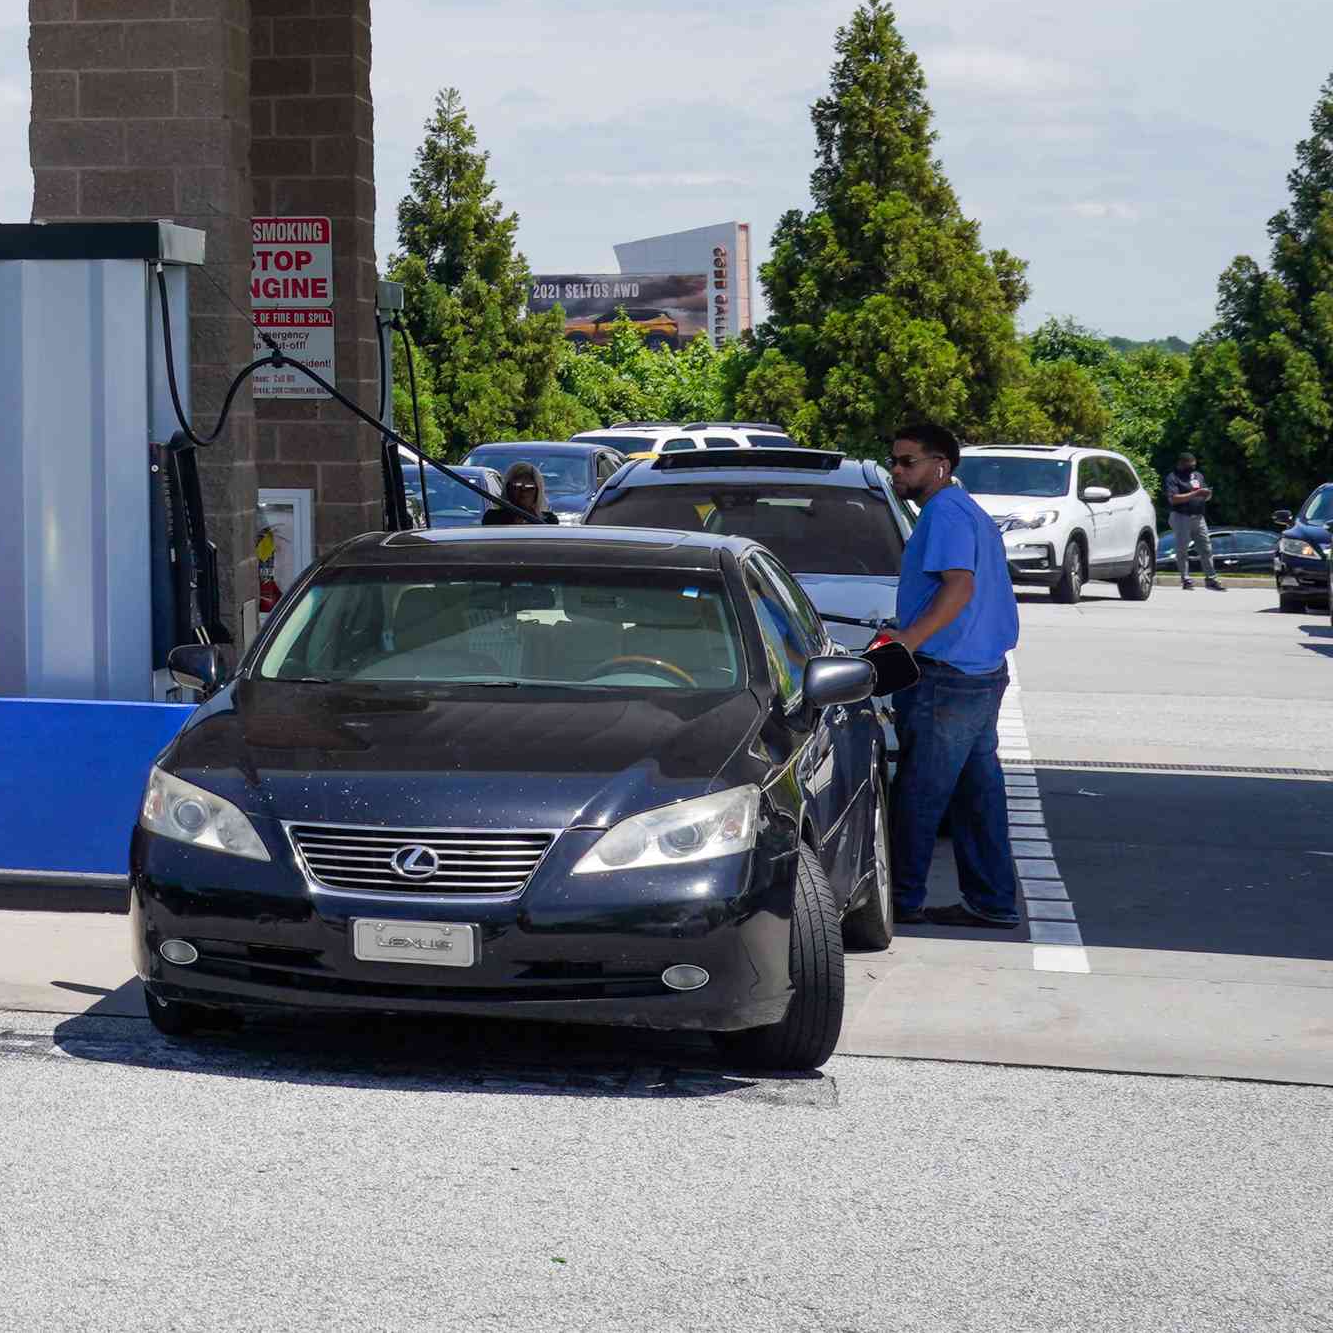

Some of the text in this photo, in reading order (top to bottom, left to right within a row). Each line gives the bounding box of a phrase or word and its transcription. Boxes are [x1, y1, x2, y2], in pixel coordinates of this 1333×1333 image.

[252, 222, 323, 242] SMOKING
[251, 278, 328, 299] NGINE
[533, 284, 560, 299] 2021
[564, 284, 610, 299] SELTOS
[613, 283, 640, 298] AWD
[260, 312, 271, 323] OF
[273, 313, 291, 323] FIRE
[308, 313, 331, 323] SPILL
[375, 936, 454, 952] LEXUS
